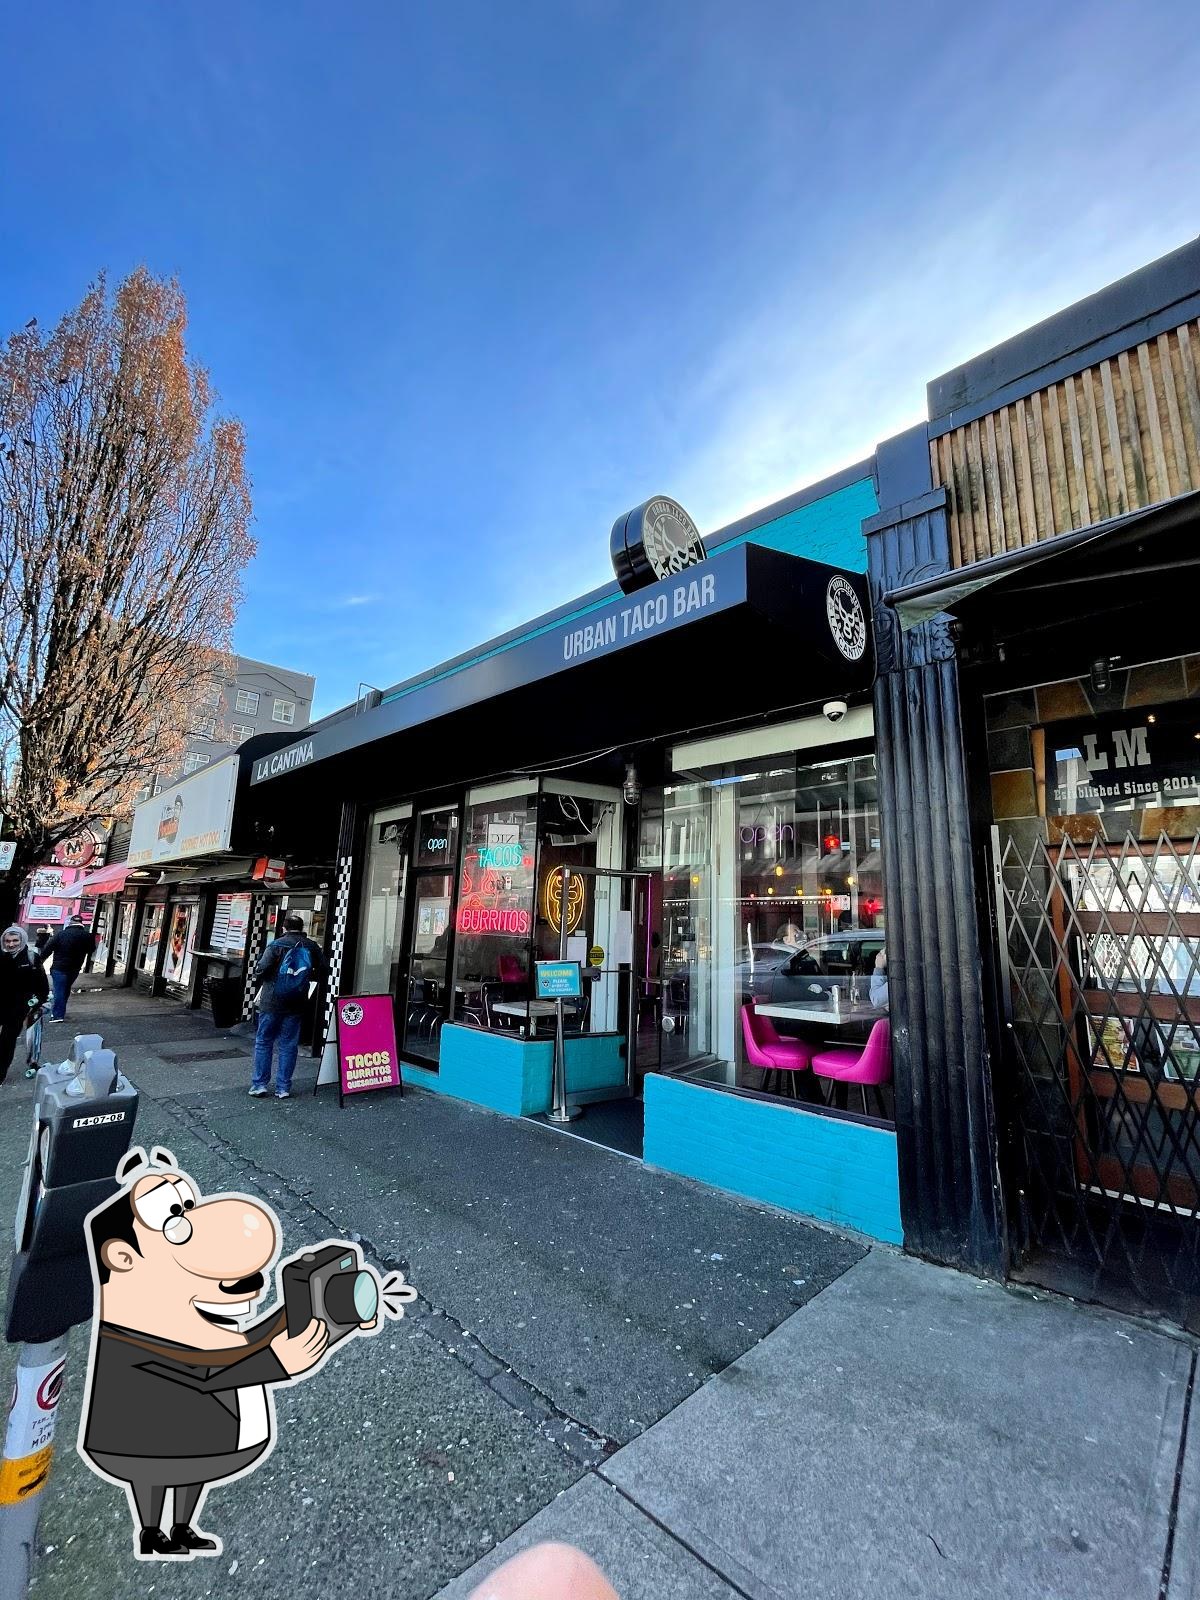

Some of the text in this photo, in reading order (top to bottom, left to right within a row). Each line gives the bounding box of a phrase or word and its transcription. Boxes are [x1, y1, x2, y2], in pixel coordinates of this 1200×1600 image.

[671, 506, 687, 525] TACO
[687, 525, 698, 544] BAR
[563, 573, 715, 660] URBAN TACO BAR
[256, 741, 314, 780] LA CANTINA
[1053, 775, 1198, 801] Esblished Since 2001
[427, 838, 448, 853] open
[740, 824, 794, 848] open
[477, 843, 522, 868] TACOS
[461, 909, 529, 934] BURRITOS
[345, 1050, 391, 1070] TACOS
[346, 1064, 392, 1081] BURRITOS
[346, 1075, 393, 1090] QUESADILLAS
[76, 1113, 123, 1127] 14-07-08
